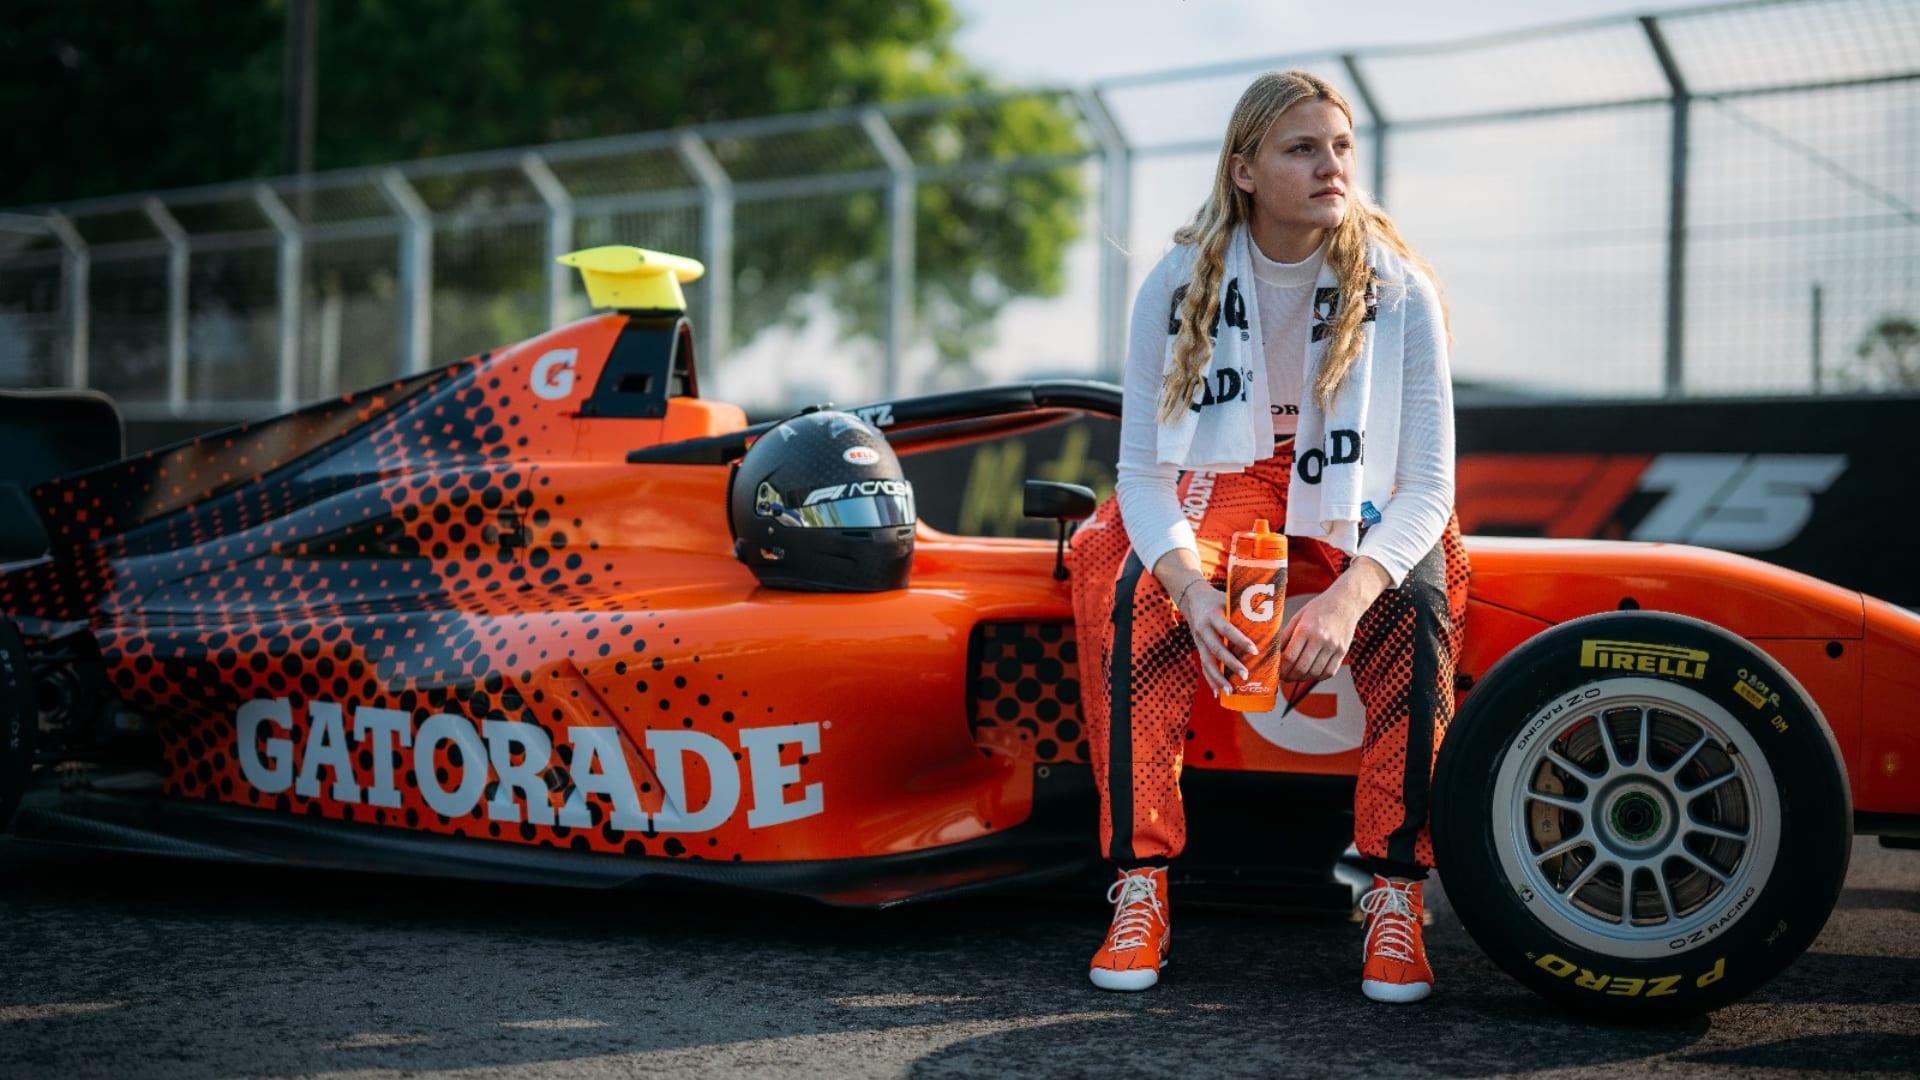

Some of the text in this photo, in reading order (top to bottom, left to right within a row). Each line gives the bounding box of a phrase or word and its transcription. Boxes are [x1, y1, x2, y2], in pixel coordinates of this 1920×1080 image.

[530, 347, 578, 400] G
[849, 451, 875, 460] BELL
[1240, 583, 1276, 623] G
[1580, 639, 1710, 680] PIRELLI
[1517, 704, 1563, 750] RACING
[236, 696, 825, 833] GATORADE
[1708, 886, 1755, 934] RACING
[1534, 953, 1726, 997] P ZERO
